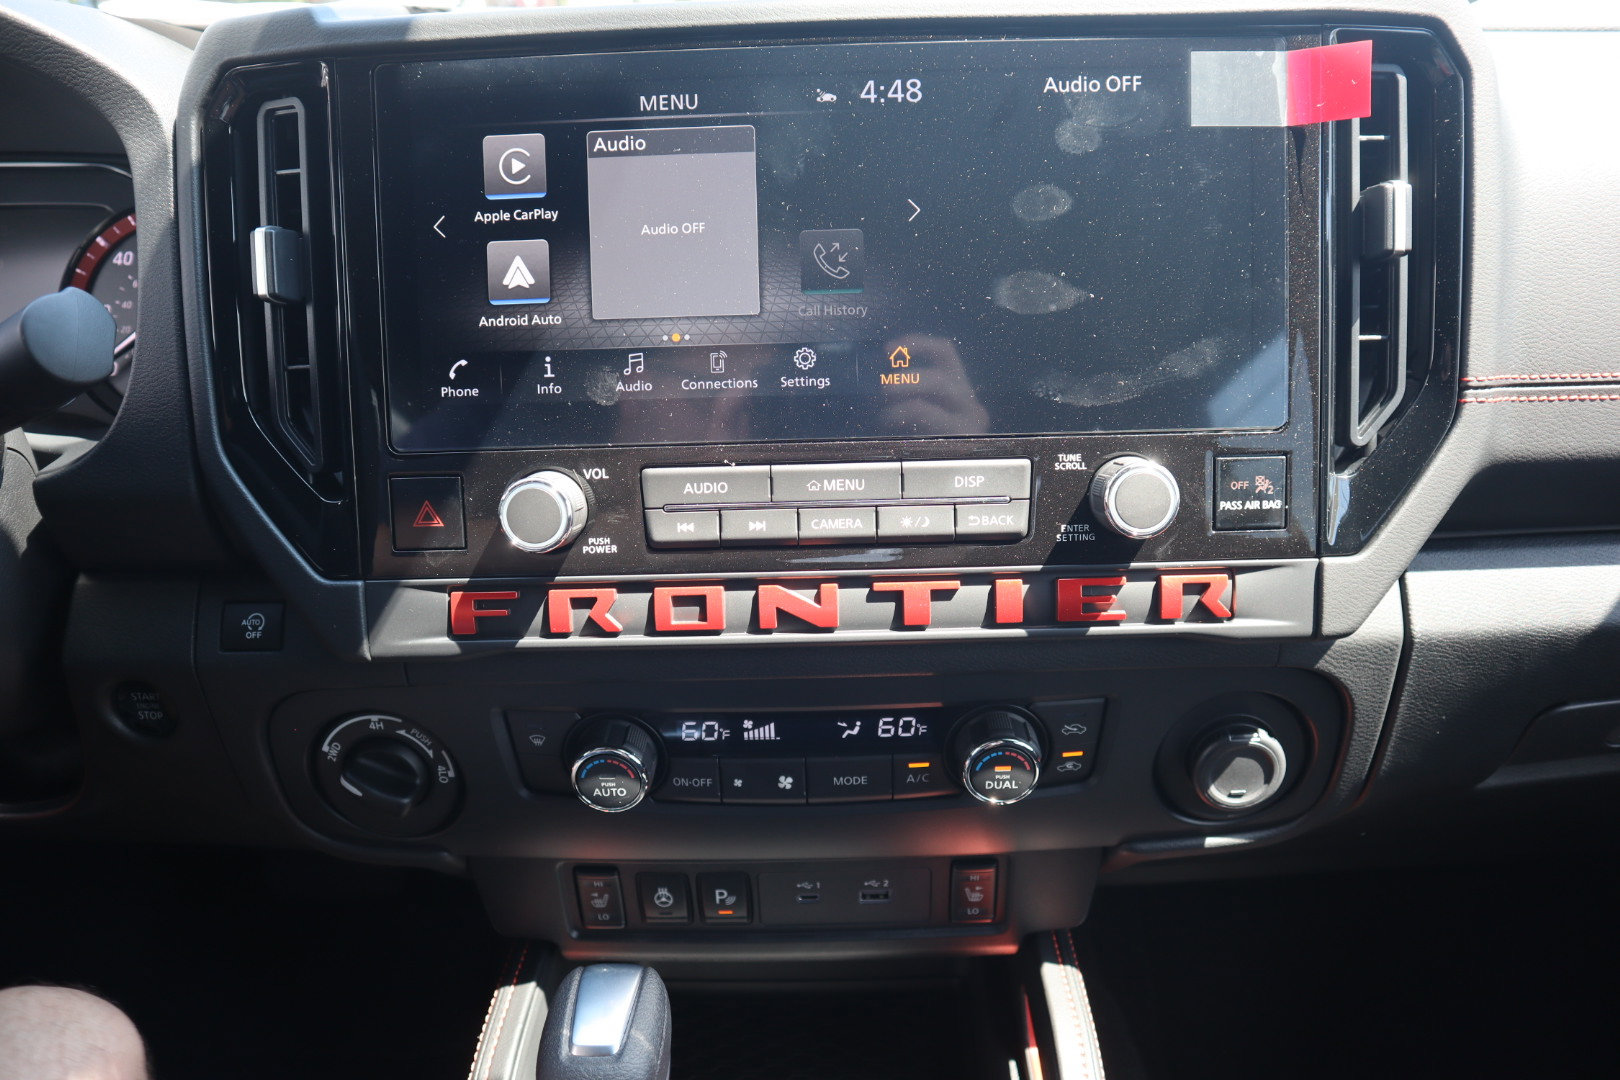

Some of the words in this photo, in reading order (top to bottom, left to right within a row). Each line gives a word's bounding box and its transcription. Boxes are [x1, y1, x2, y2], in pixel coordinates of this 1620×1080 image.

[860, 78, 923, 103] 4:48
[1043, 76, 1100, 94] Audio
[1105, 75, 1142, 92] OFF
[639, 94, 699, 112] MENU
[593, 136, 647, 152] Audio
[474, 210, 511, 224] Apple
[513, 207, 559, 222] CarPlay
[640, 223, 679, 235] Audio
[681, 222, 706, 234] OFF
[112, 251, 134, 266] 40
[798, 304, 822, 317] Call
[824, 304, 868, 318] History
[479, 315, 529, 327] Android
[531, 313, 562, 326] Auto
[681, 377, 758, 390] Connections
[780, 375, 831, 389] Settings
[880, 373, 920, 385] MENU
[441, 386, 479, 398] Phone
[537, 383, 562, 395] Info
[616, 380, 653, 392] Audio
[1058, 453, 1083, 463] TUNE
[1054, 462, 1087, 471] SCROLL
[582, 467, 610, 480] VOL
[823, 478, 865, 492] MENU
[954, 475, 985, 488] DISP
[1230, 481, 1250, 490] OFF
[683, 482, 729, 495] AUDIO
[1219, 501, 1243, 511] PASS
[1244, 501, 1261, 510] AIR
[1262, 500, 1282, 510] BAG
[811, 518, 863, 530] CAMERA
[981, 515, 1014, 527] BACK
[1060, 524, 1090, 533] ENTER
[588, 537, 611, 546] PUSH
[1056, 532, 1096, 542] SETTING
[582, 545, 618, 554] POWER
[450, 573, 1232, 635] FRONTIER
[245, 631, 263, 639] OFF
[130, 692, 160, 701] START
[137, 711, 164, 720] STOP
[369, 721, 384, 730] 4H
[410, 728, 433, 746] PUSH
[327, 742, 341, 762] 2WD
[437, 765, 449, 784] 4LO
[833, 775, 868, 786] MODE
[906, 773, 930, 784] A/C
[985, 780, 1019, 790] DUAL
[593, 787, 627, 797] AUTO
